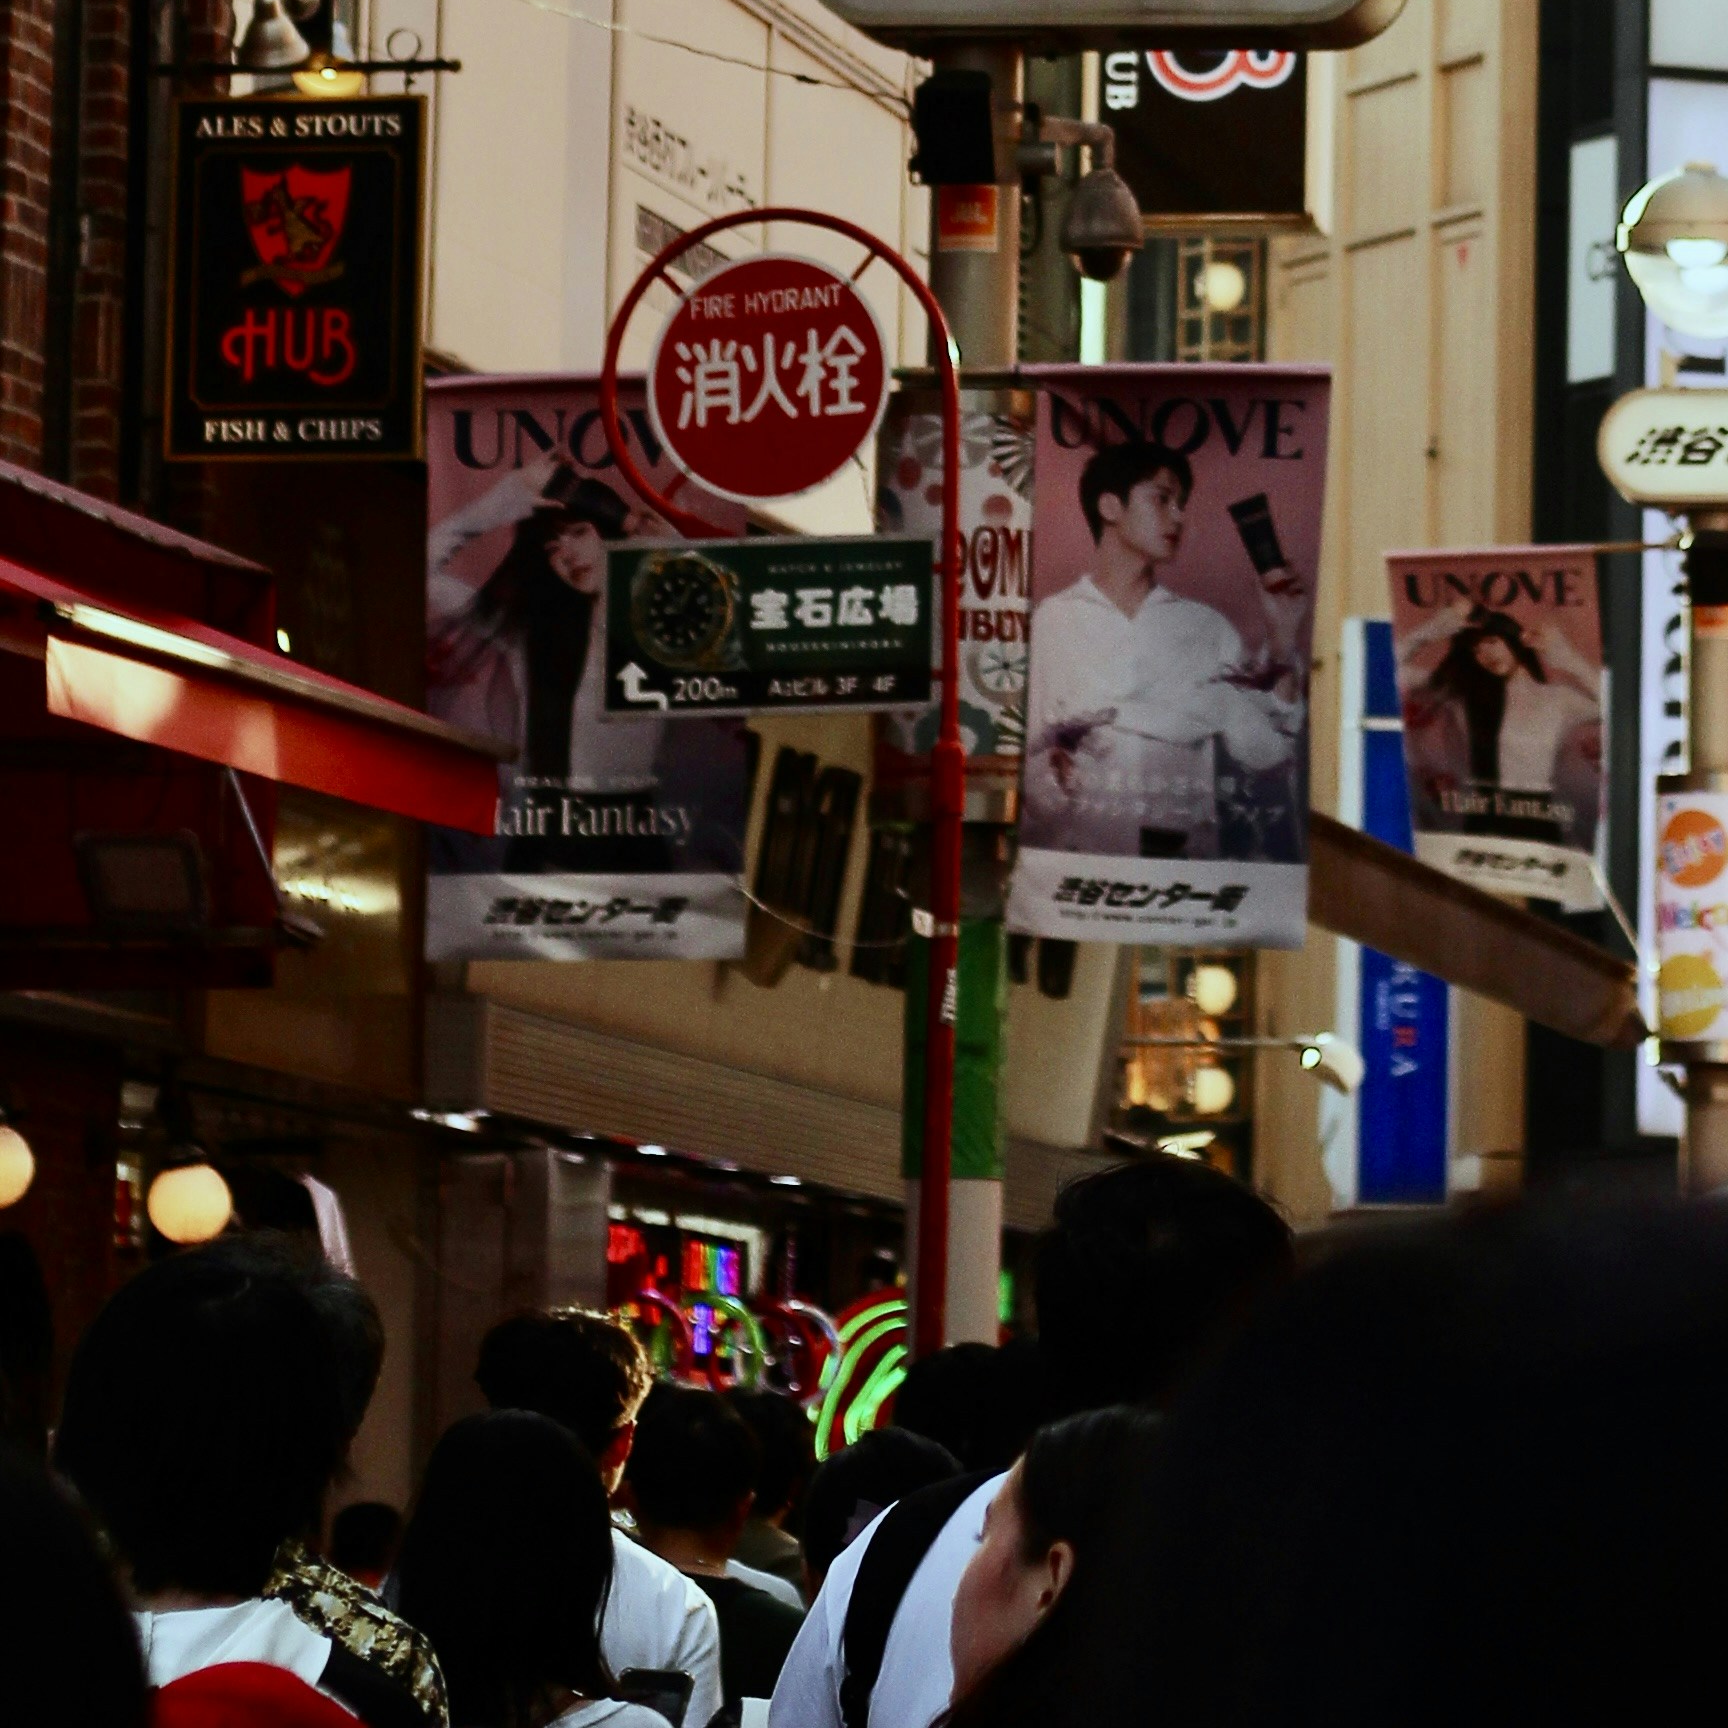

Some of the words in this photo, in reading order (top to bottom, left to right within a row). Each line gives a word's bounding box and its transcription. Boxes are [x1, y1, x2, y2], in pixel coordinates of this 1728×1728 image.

[196, 114, 264, 137] ALES
[270, 114, 289, 137] &
[294, 113, 402, 137] STOUTS
[690, 295, 736, 320] FIRE
[743, 282, 845, 315] HYDRANT
[221, 307, 356, 386] HUB
[676, 324, 867, 430] 消火栓
[205, 420, 266, 443] FISH
[273, 420, 292, 443] &
[297, 419, 382, 443] CHIPS
[1051, 398, 1307, 461] UNOVE
[750, 584, 919, 630] 宝石広場
[1404, 569, 1584, 608] UNOVE
[560, 796, 693, 846] Fantasy
